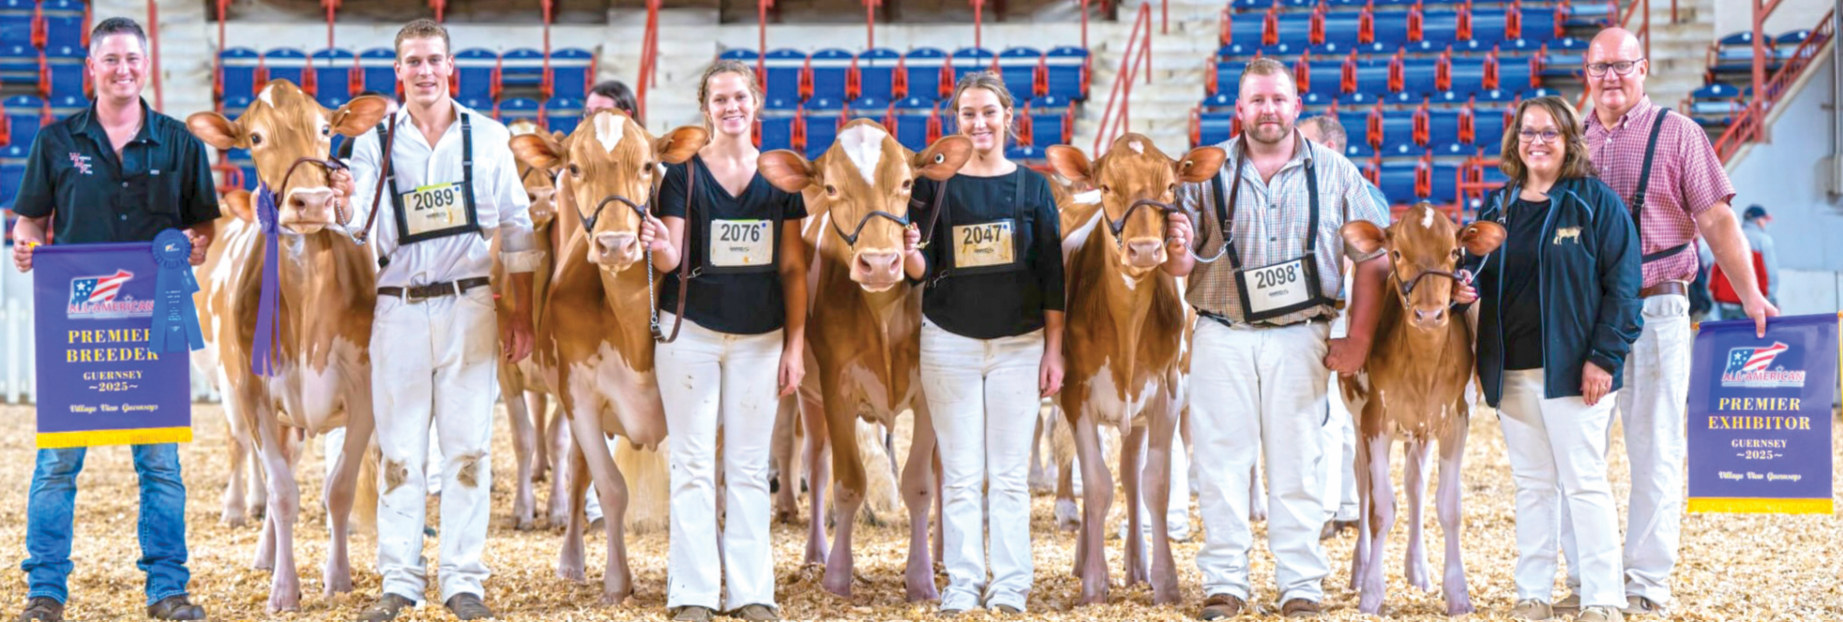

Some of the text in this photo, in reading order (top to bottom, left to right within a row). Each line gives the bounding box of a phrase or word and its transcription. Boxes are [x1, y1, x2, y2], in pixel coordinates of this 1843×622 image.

[413, 188, 454, 211] 2089
[720, 223, 760, 242] 2076
[962, 224, 1002, 245] 2047
[1255, 265, 1297, 289] 2098
[83, 370, 143, 380] GUERNSEY
[1718, 397, 1801, 411] PREMIER
[1708, 415, 1811, 430] EXHIBITOR
[1731, 439, 1788, 448] GUERNSEY
